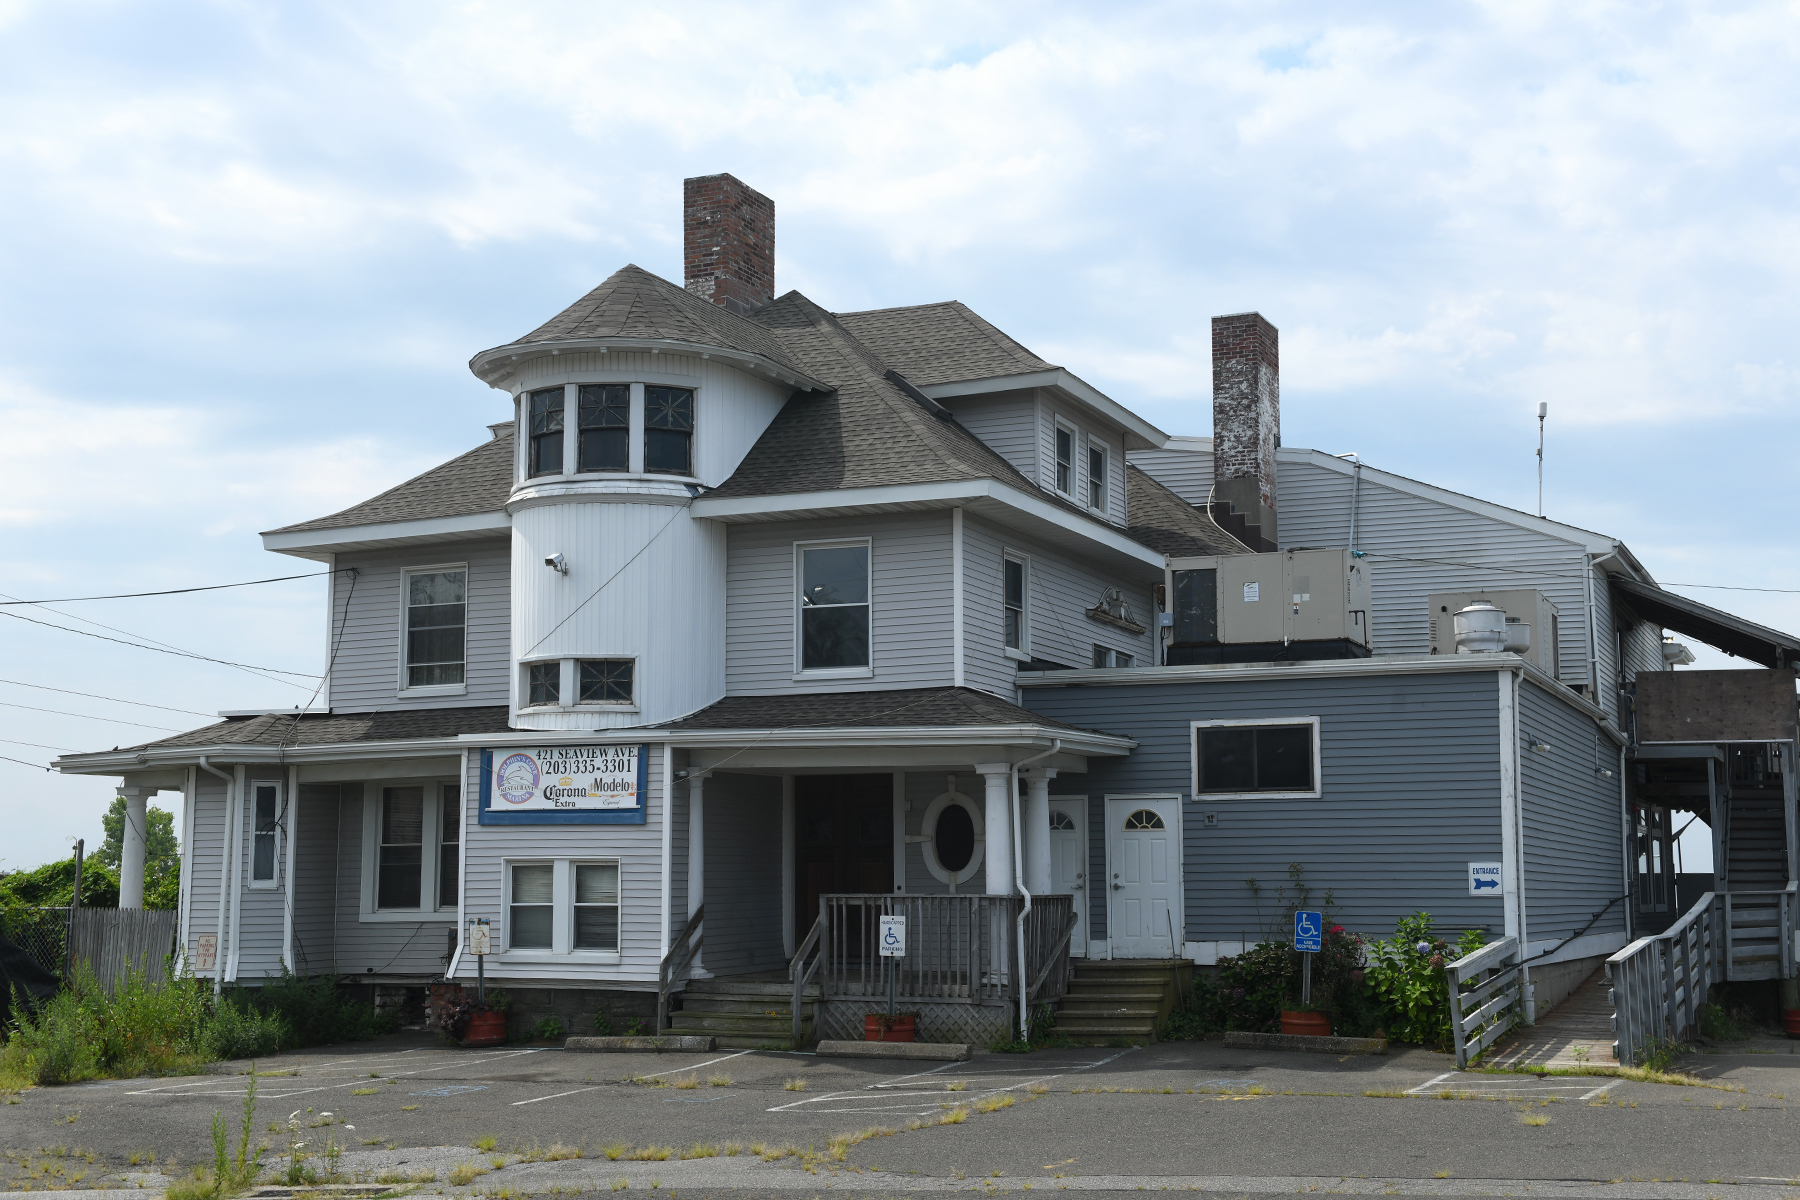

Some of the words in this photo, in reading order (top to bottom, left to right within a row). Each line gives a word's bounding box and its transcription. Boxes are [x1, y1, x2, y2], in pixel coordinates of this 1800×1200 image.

[536, 749, 553, 760] 421
[558, 748, 609, 760] SEAVIEW
[612, 747, 638, 758] AVE.
[500, 755, 526, 776] DOLPHIN'S
[526, 758, 538, 775] COVE
[541, 759, 632, 776] (203)335-3301
[500, 784, 534, 794] RESTAURANT
[593, 777, 630, 792] Modelo
[505, 792, 530, 802] MARINA
[543, 785, 587, 802] Corona
[554, 798, 576, 808] Extra
[1472, 867, 1500, 875] ENTRANCE
